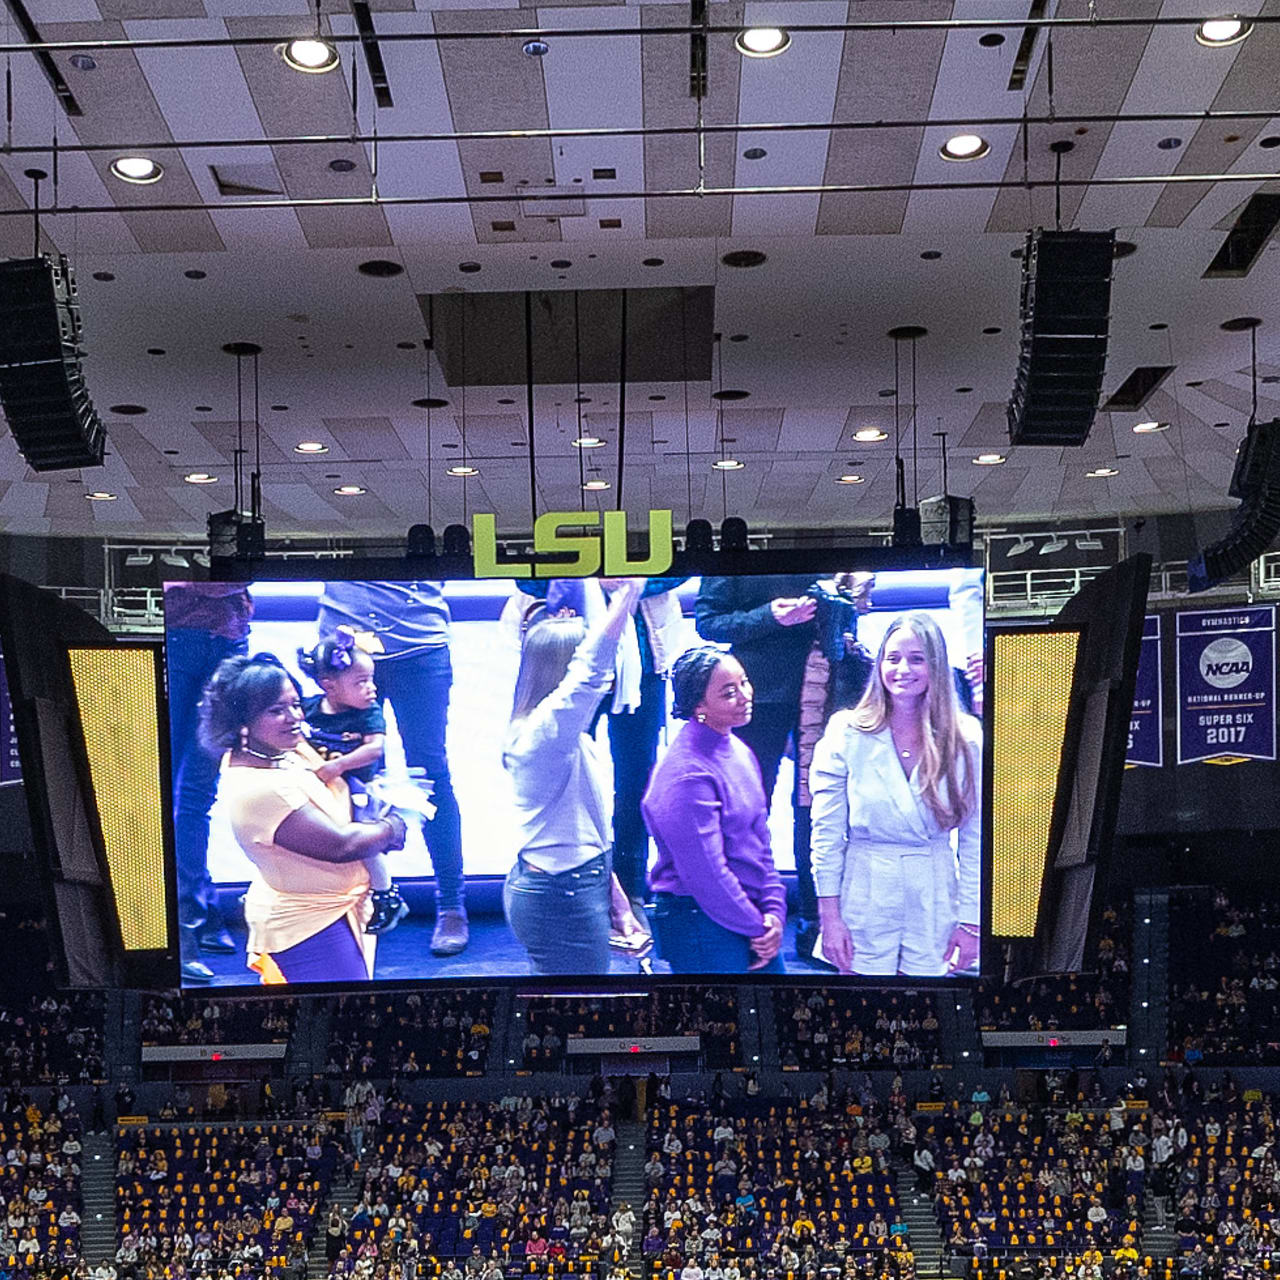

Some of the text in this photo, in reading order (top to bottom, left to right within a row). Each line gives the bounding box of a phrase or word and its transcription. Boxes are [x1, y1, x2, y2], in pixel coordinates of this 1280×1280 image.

[473, 509, 674, 579] LSU
[1206, 661, 1251, 677] NCAA
[1129, 721, 1140, 730] IX
[1199, 713, 1254, 726] SUPER SIX
[1207, 727, 1246, 744] 2017
